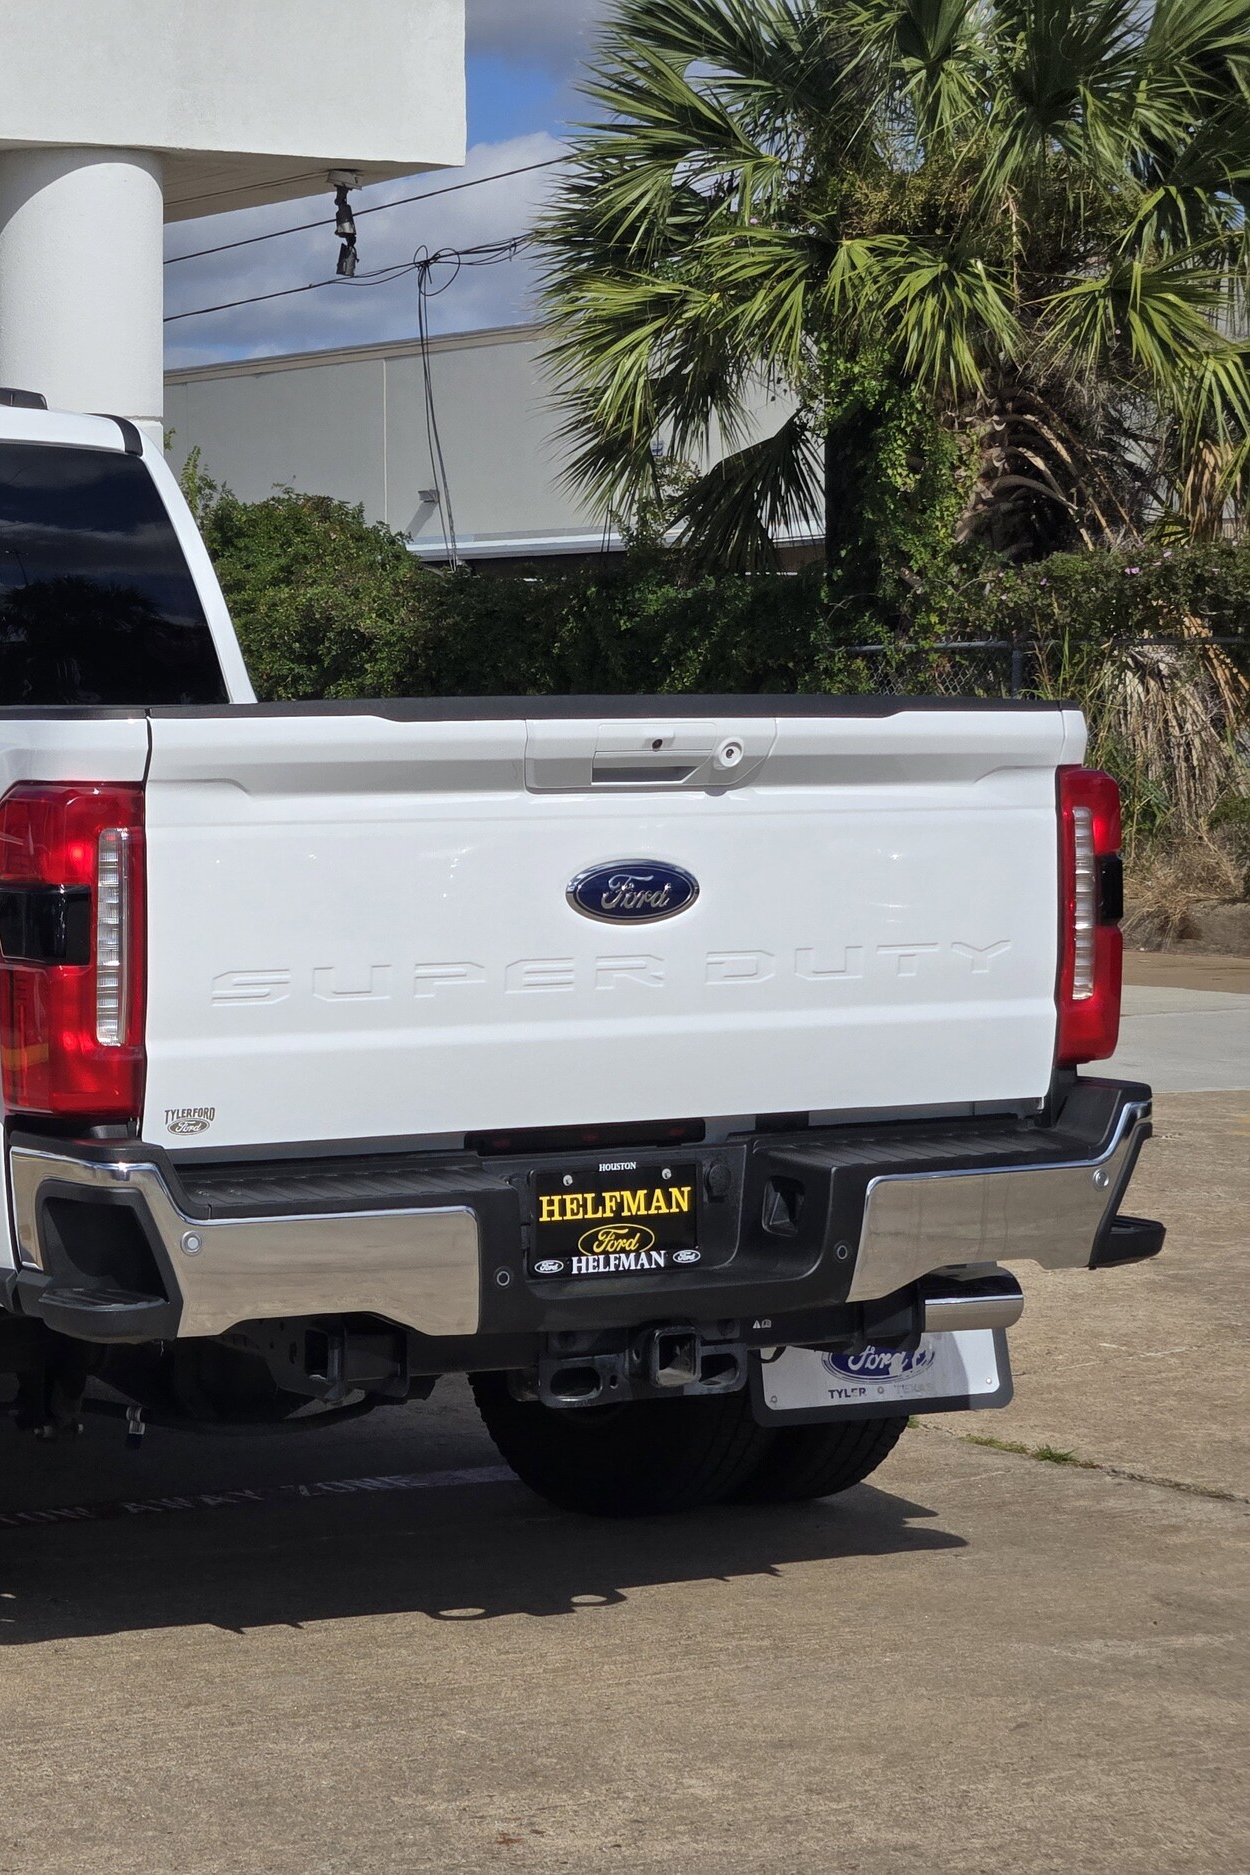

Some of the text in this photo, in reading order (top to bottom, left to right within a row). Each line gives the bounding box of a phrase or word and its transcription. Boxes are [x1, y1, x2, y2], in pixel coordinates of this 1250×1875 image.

[600, 873, 672, 910] Ford
[211, 939, 1013, 1006] SUPER DUTY
[175, 1120, 202, 1132] Ford
[598, 1161, 637, 1172] HOUSTON
[538, 1186, 692, 1222] HELFMAN
[592, 1228, 641, 1253] Ford
[571, 1250, 667, 1275] HELFMAN
[828, 1387, 867, 1399] TYLER
[122, 1489, 265, 1514] AWAY
